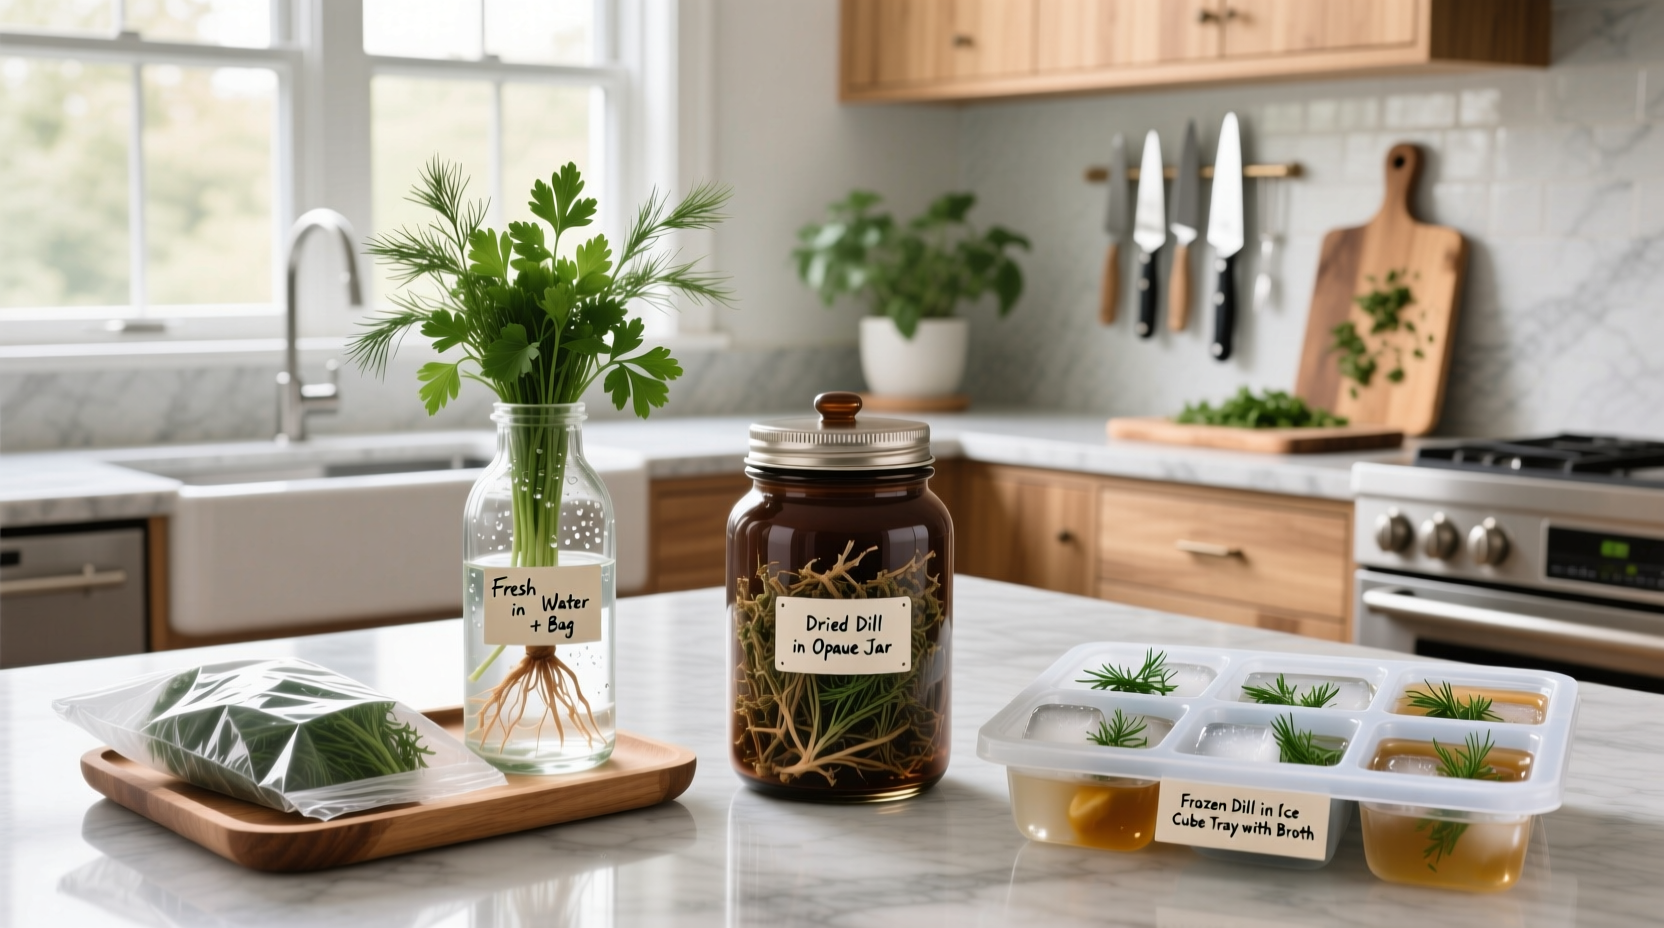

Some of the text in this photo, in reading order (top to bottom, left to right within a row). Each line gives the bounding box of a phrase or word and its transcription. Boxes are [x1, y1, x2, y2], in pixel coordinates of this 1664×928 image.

[491, 576, 536, 598] Fresh
[512, 593, 590, 617] in Water
[530, 615, 574, 639] + Bag
[806, 614, 882, 633] Dried Dill
[793, 638, 892, 661] in Opaue Jar
[1180, 793, 1299, 819] Frozen Dill in Ice
[1172, 812, 1315, 841] Cube Tray with Broth
